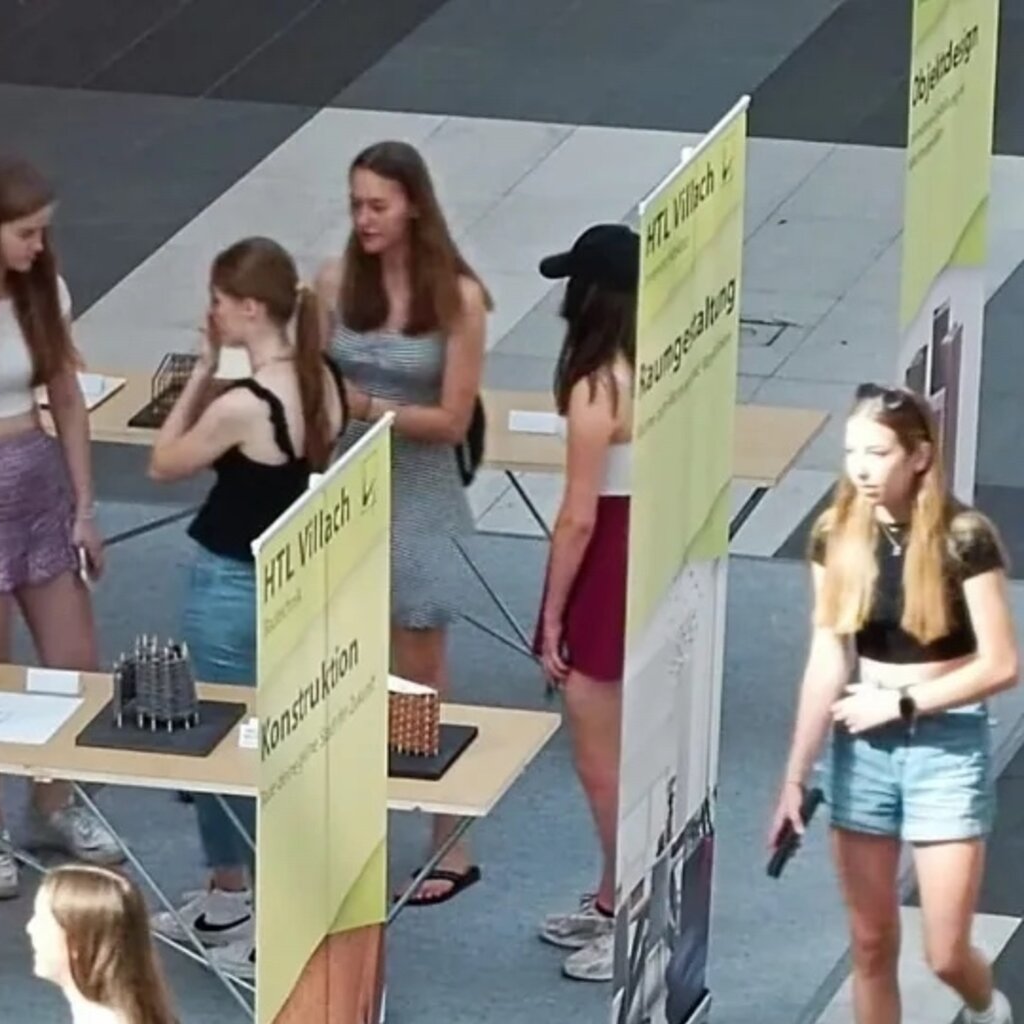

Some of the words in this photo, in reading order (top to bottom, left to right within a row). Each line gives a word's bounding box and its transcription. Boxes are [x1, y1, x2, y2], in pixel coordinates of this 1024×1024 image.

[645, 207, 670, 257] HTL
[673, 162, 714, 228] Villach
[264, 543, 294, 603] HTL
[298, 487, 350, 566] Villach
[261, 638, 359, 762] Konstruktion
